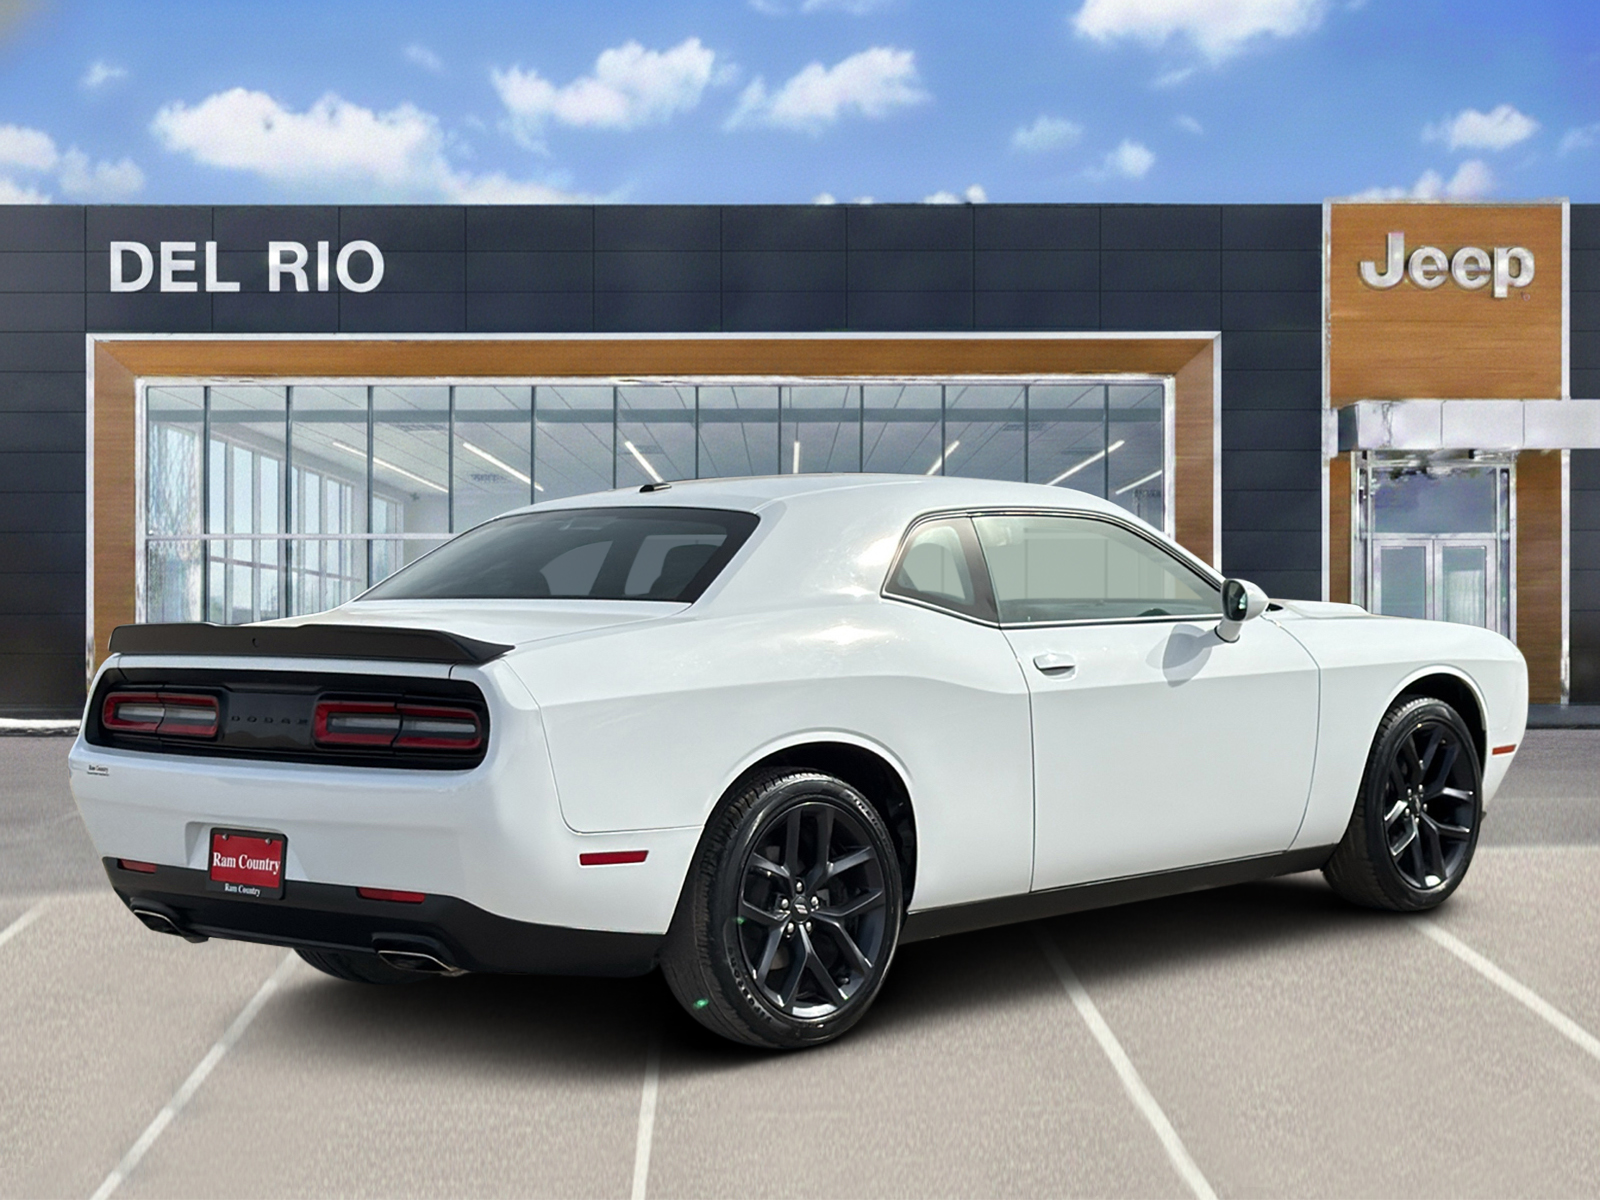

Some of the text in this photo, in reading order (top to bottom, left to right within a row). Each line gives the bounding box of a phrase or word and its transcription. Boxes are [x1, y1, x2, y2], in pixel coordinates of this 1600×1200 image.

[110, 240, 385, 293] DEL RIO
[1359, 231, 1535, 298] Jeep
[212, 851, 281, 876] Ram Country
[224, 882, 261, 898] Ram Country
